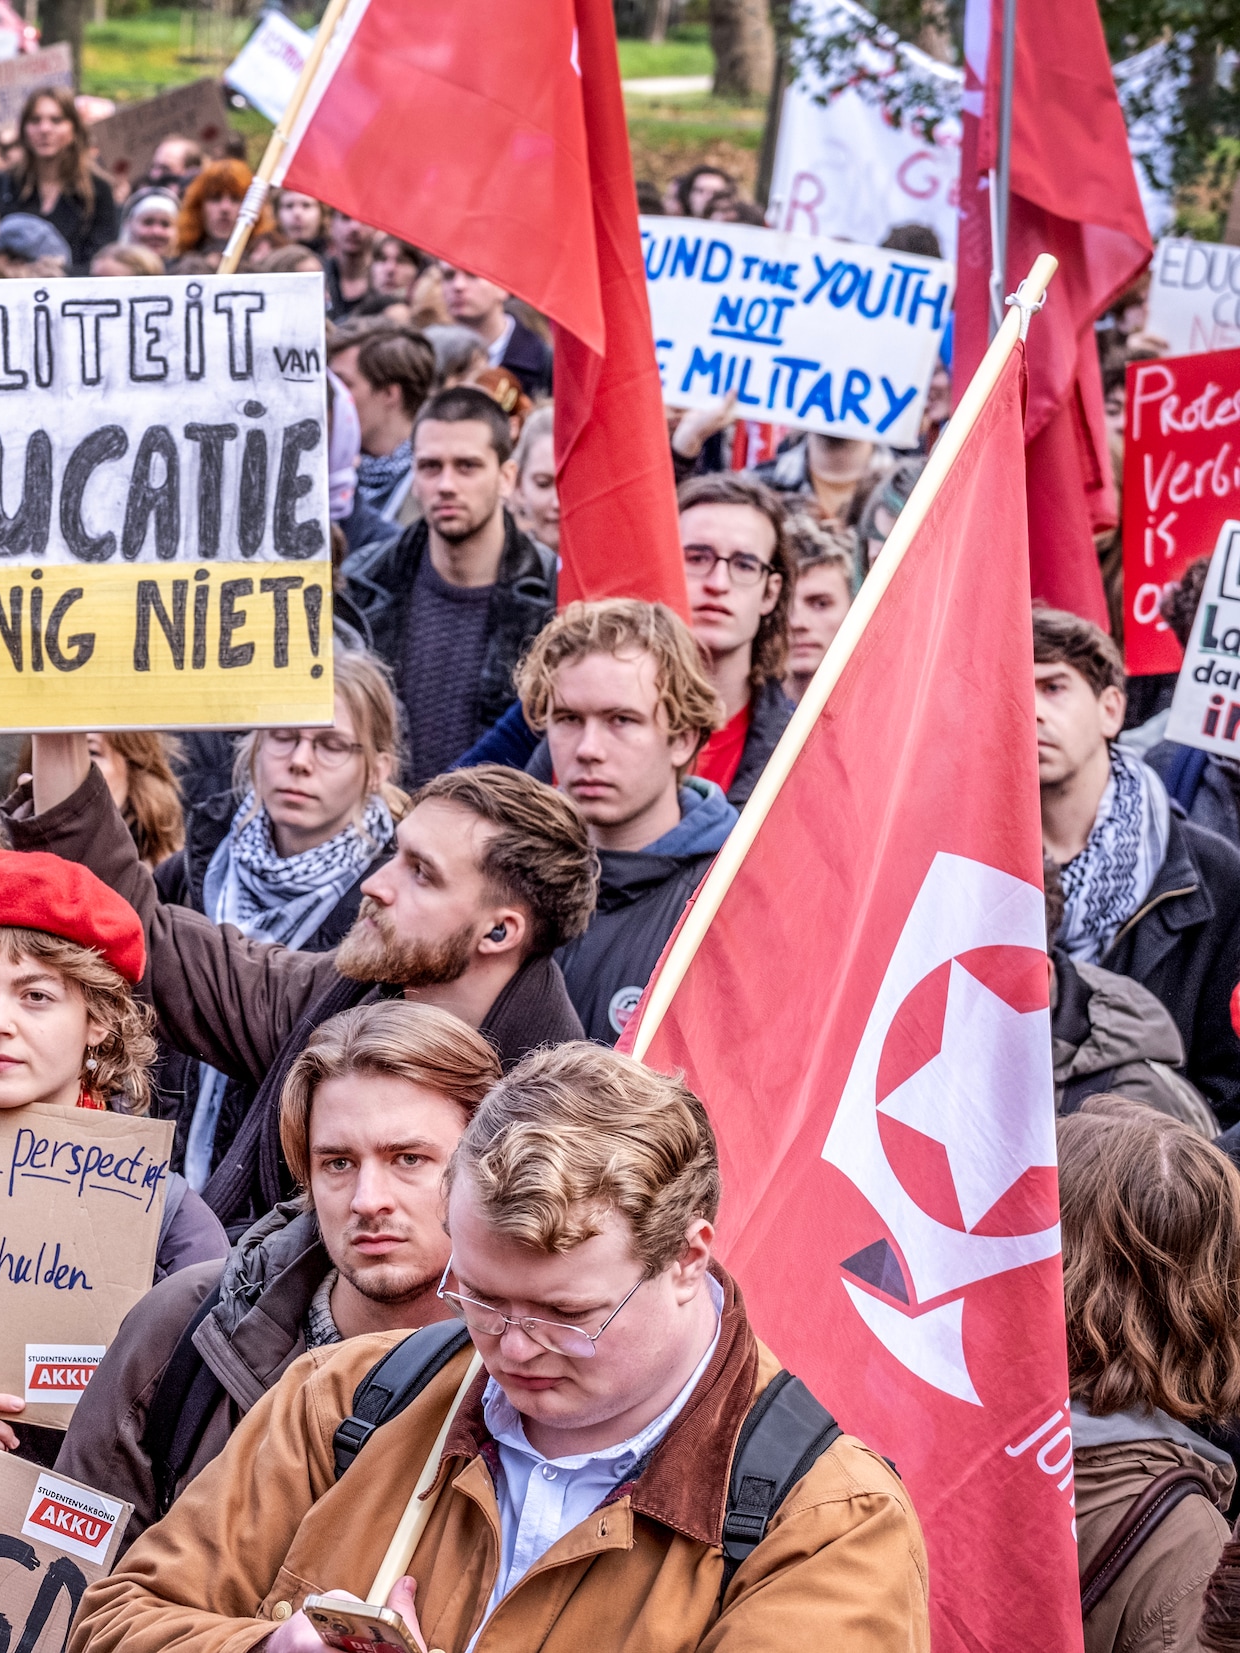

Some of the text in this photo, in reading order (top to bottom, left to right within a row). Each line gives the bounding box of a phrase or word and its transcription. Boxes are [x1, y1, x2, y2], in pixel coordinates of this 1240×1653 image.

[742, 256, 799, 290] THE
[803, 254, 947, 330] YOUTH
[713, 295, 795, 335] NOT
[680, 346, 917, 434] MILITARY
[37, 1367, 95, 1386] AKKU
[37, 1485, 116, 1523] STUDENTENVAKBOND
[40, 1504, 102, 1541] AKKU
